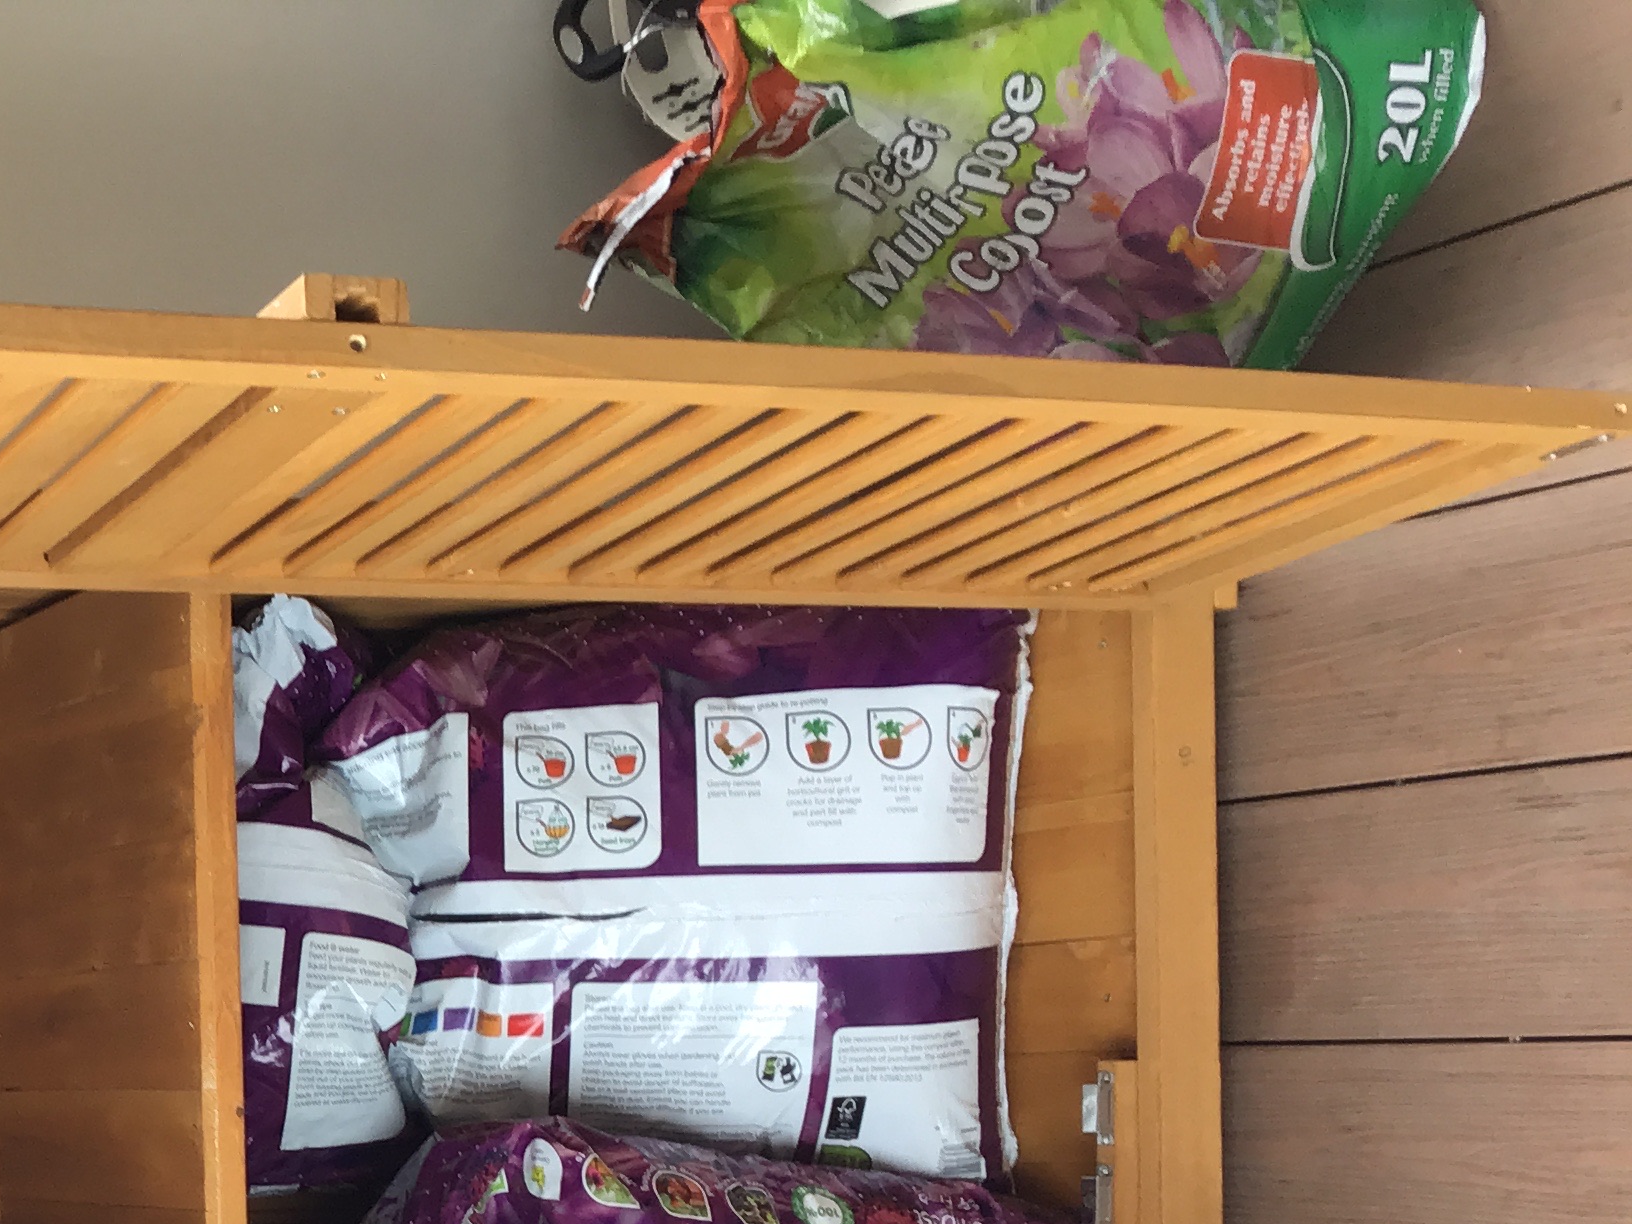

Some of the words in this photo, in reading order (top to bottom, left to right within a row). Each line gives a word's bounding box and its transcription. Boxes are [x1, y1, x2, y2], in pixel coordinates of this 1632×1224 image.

[1212, 127, 1248, 221] Absorbs
[1239, 79, 1255, 123] and
[1243, 113, 1270, 193] retains
[1258, 104, 1292, 207] moisture
[1378, 49, 1433, 164] 20L
[1419, 108, 1444, 164] when
[1433, 48, 1455, 101] filled
